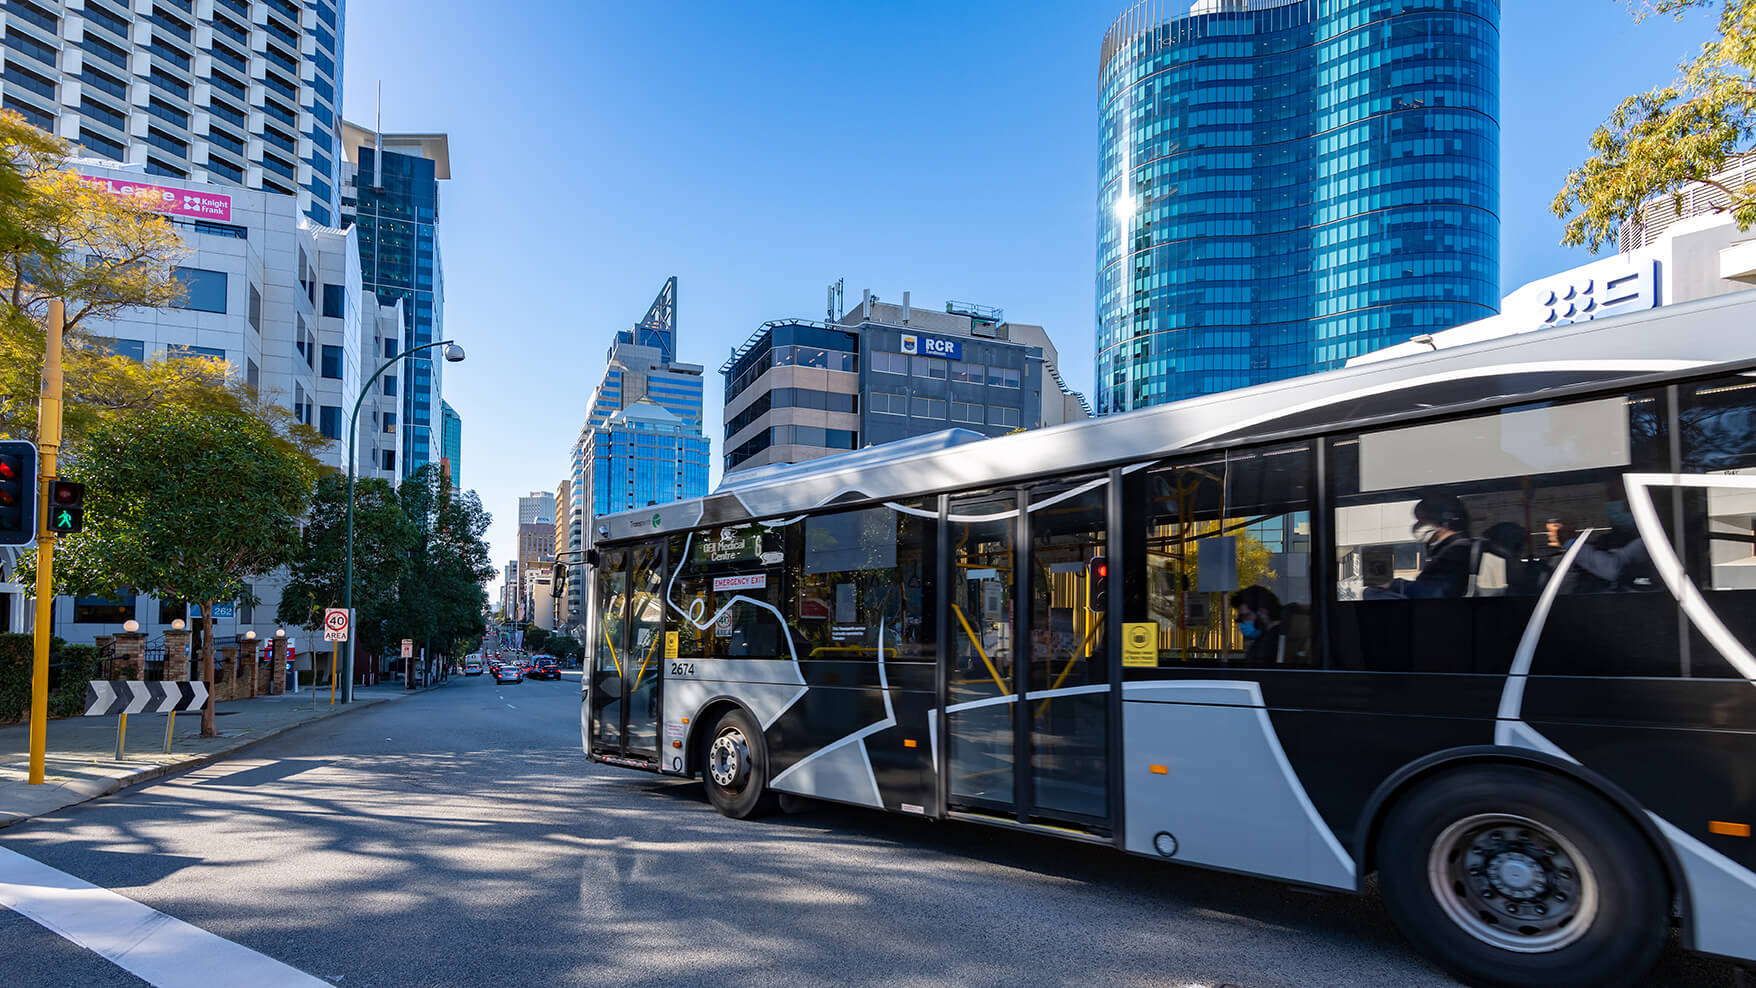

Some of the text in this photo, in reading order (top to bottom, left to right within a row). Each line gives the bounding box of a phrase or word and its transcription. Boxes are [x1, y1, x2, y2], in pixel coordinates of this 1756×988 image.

[108, 181, 175, 201] Lease
[201, 198, 228, 209] Knight
[201, 206, 224, 215] Frank
[926, 338, 954, 353] RCR
[719, 539, 745, 551] Medical
[711, 552, 736, 561] Centre
[715, 575, 765, 587] EMERGENCY EXIT
[214, 607, 233, 616] 262
[329, 616, 345, 626] 40
[671, 662, 694, 675] 2674
